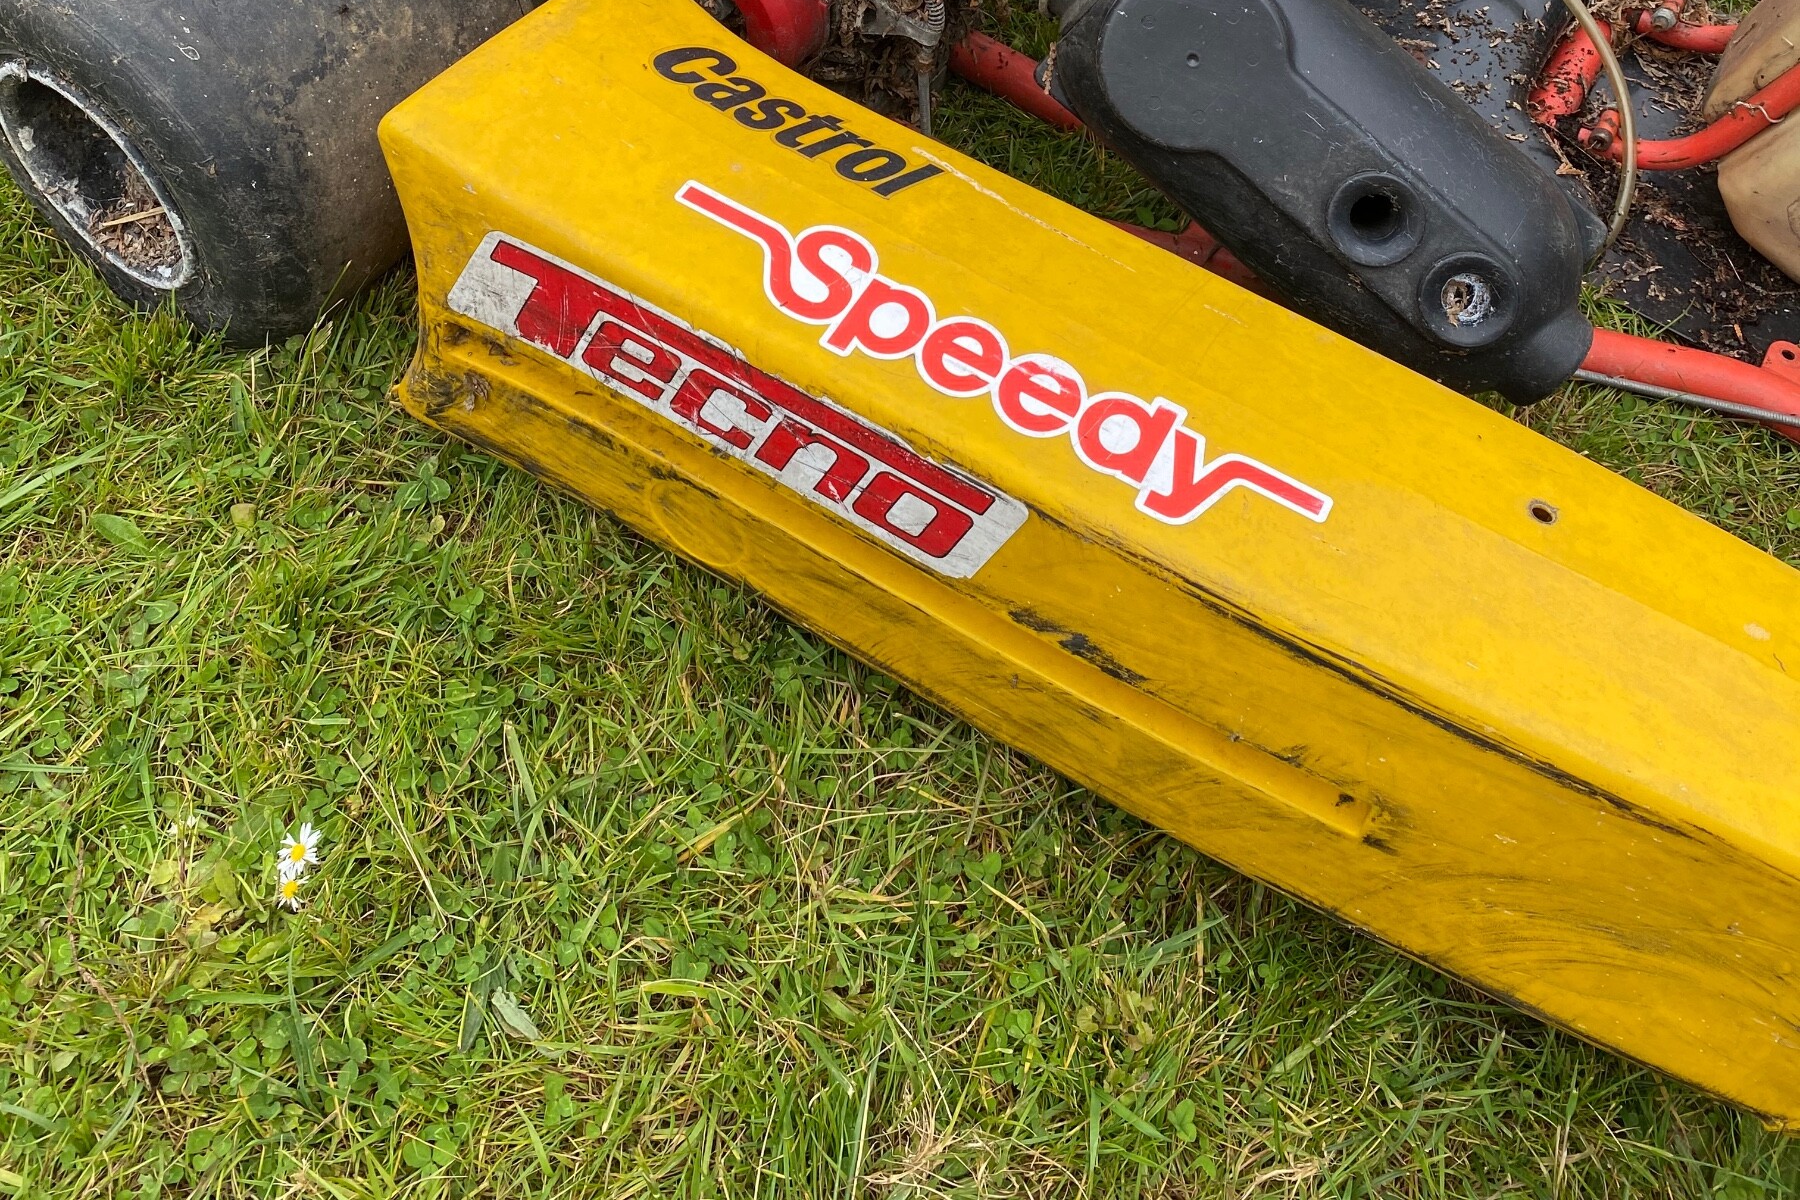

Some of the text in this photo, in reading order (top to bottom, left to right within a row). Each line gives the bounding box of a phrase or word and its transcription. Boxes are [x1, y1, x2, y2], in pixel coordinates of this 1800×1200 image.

[653, 46, 945, 197] Castrol
[489, 239, 997, 558] Tecno
[678, 184, 1330, 518] Speedy
